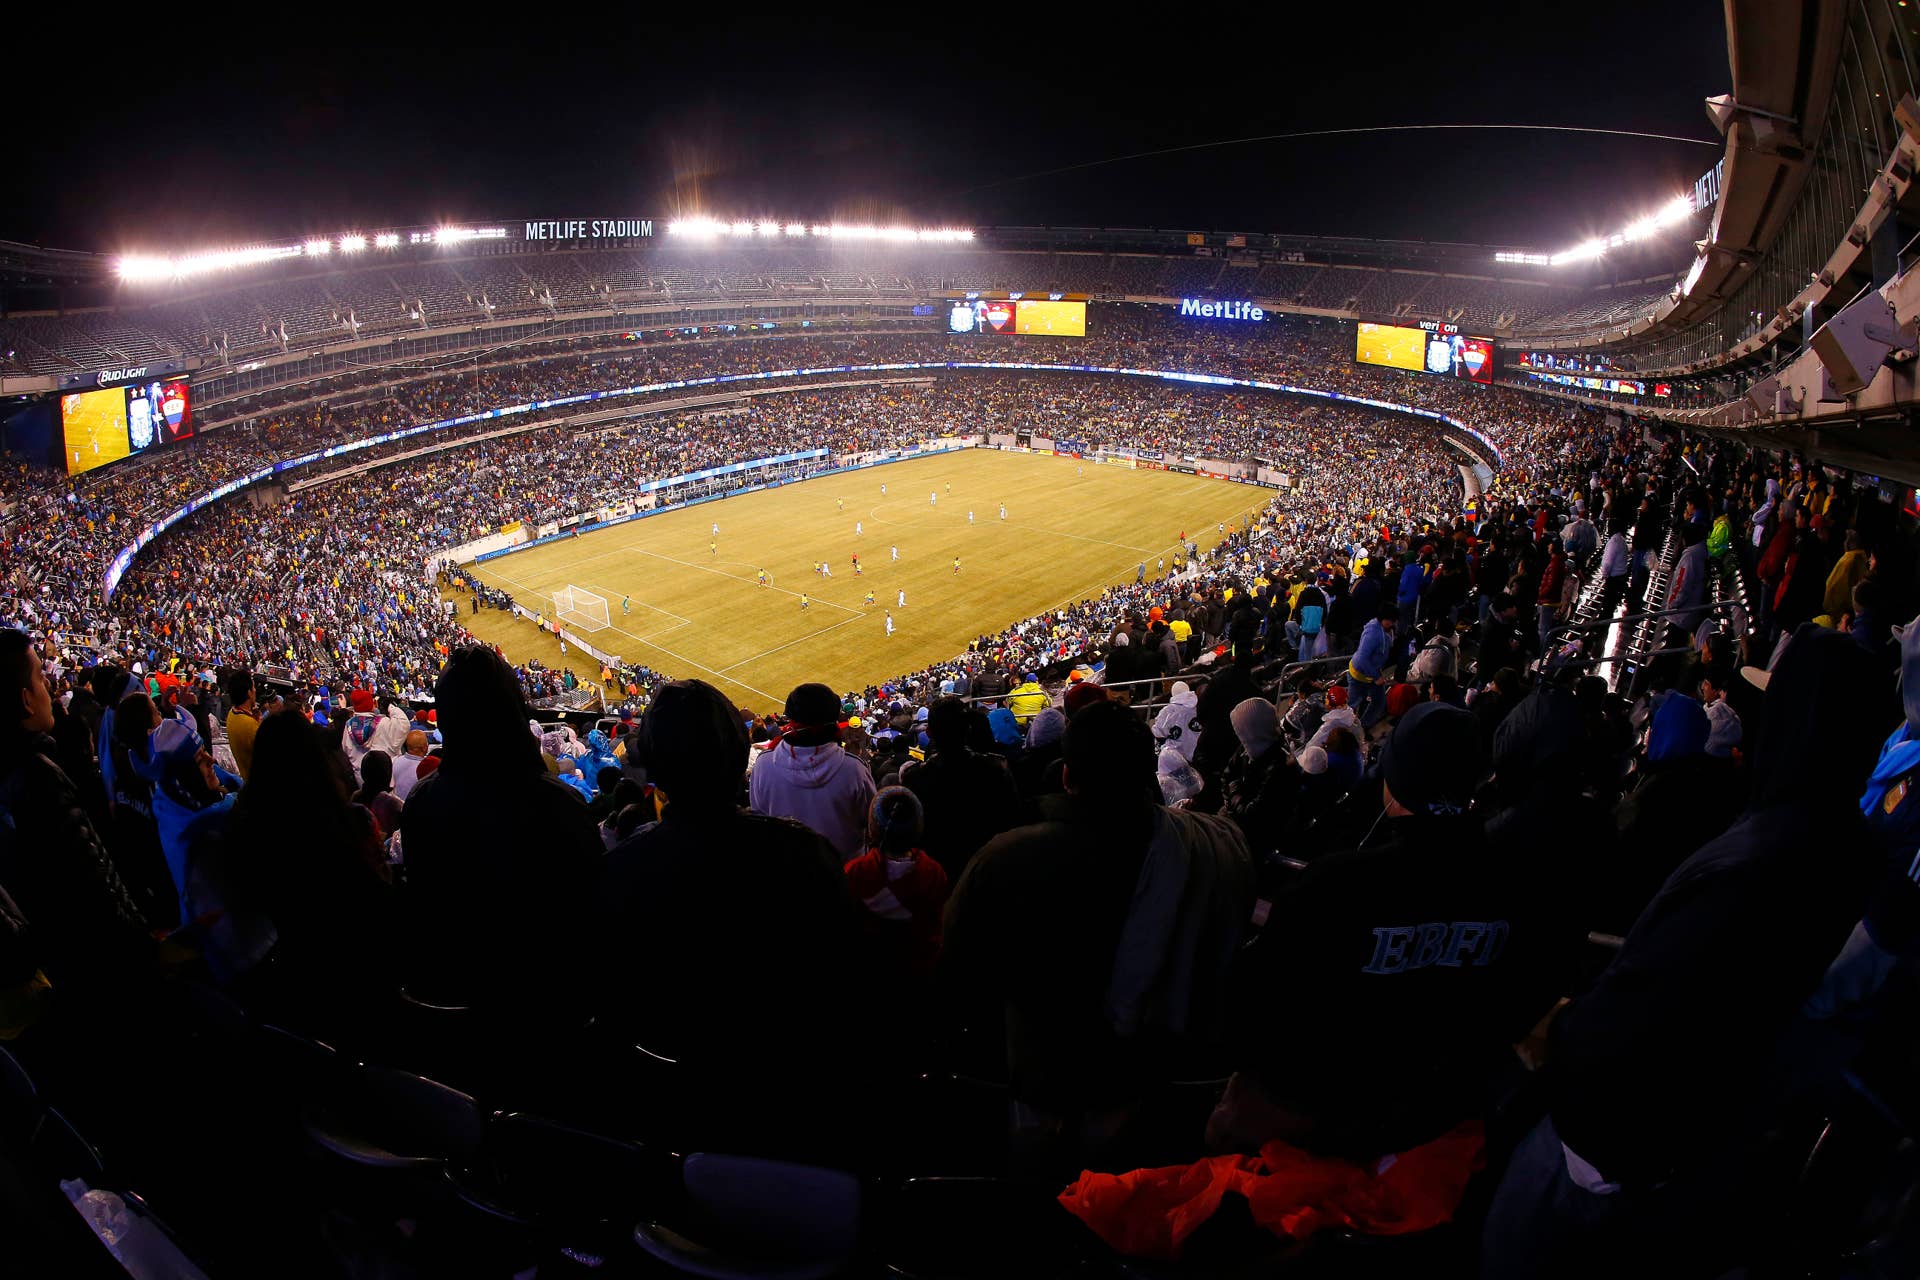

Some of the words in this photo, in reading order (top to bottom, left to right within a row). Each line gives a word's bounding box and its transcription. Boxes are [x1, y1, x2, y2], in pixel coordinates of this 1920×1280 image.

[1695, 157, 1725, 212] METLIF
[526, 221, 587, 240] METLIFE
[592, 220, 653, 238] STADIUM
[1181, 298, 1264, 321] MetLife
[1419, 320, 1458, 334] verizon
[101, 370, 121, 382] BUD
[122, 367, 147, 380] LIGHT
